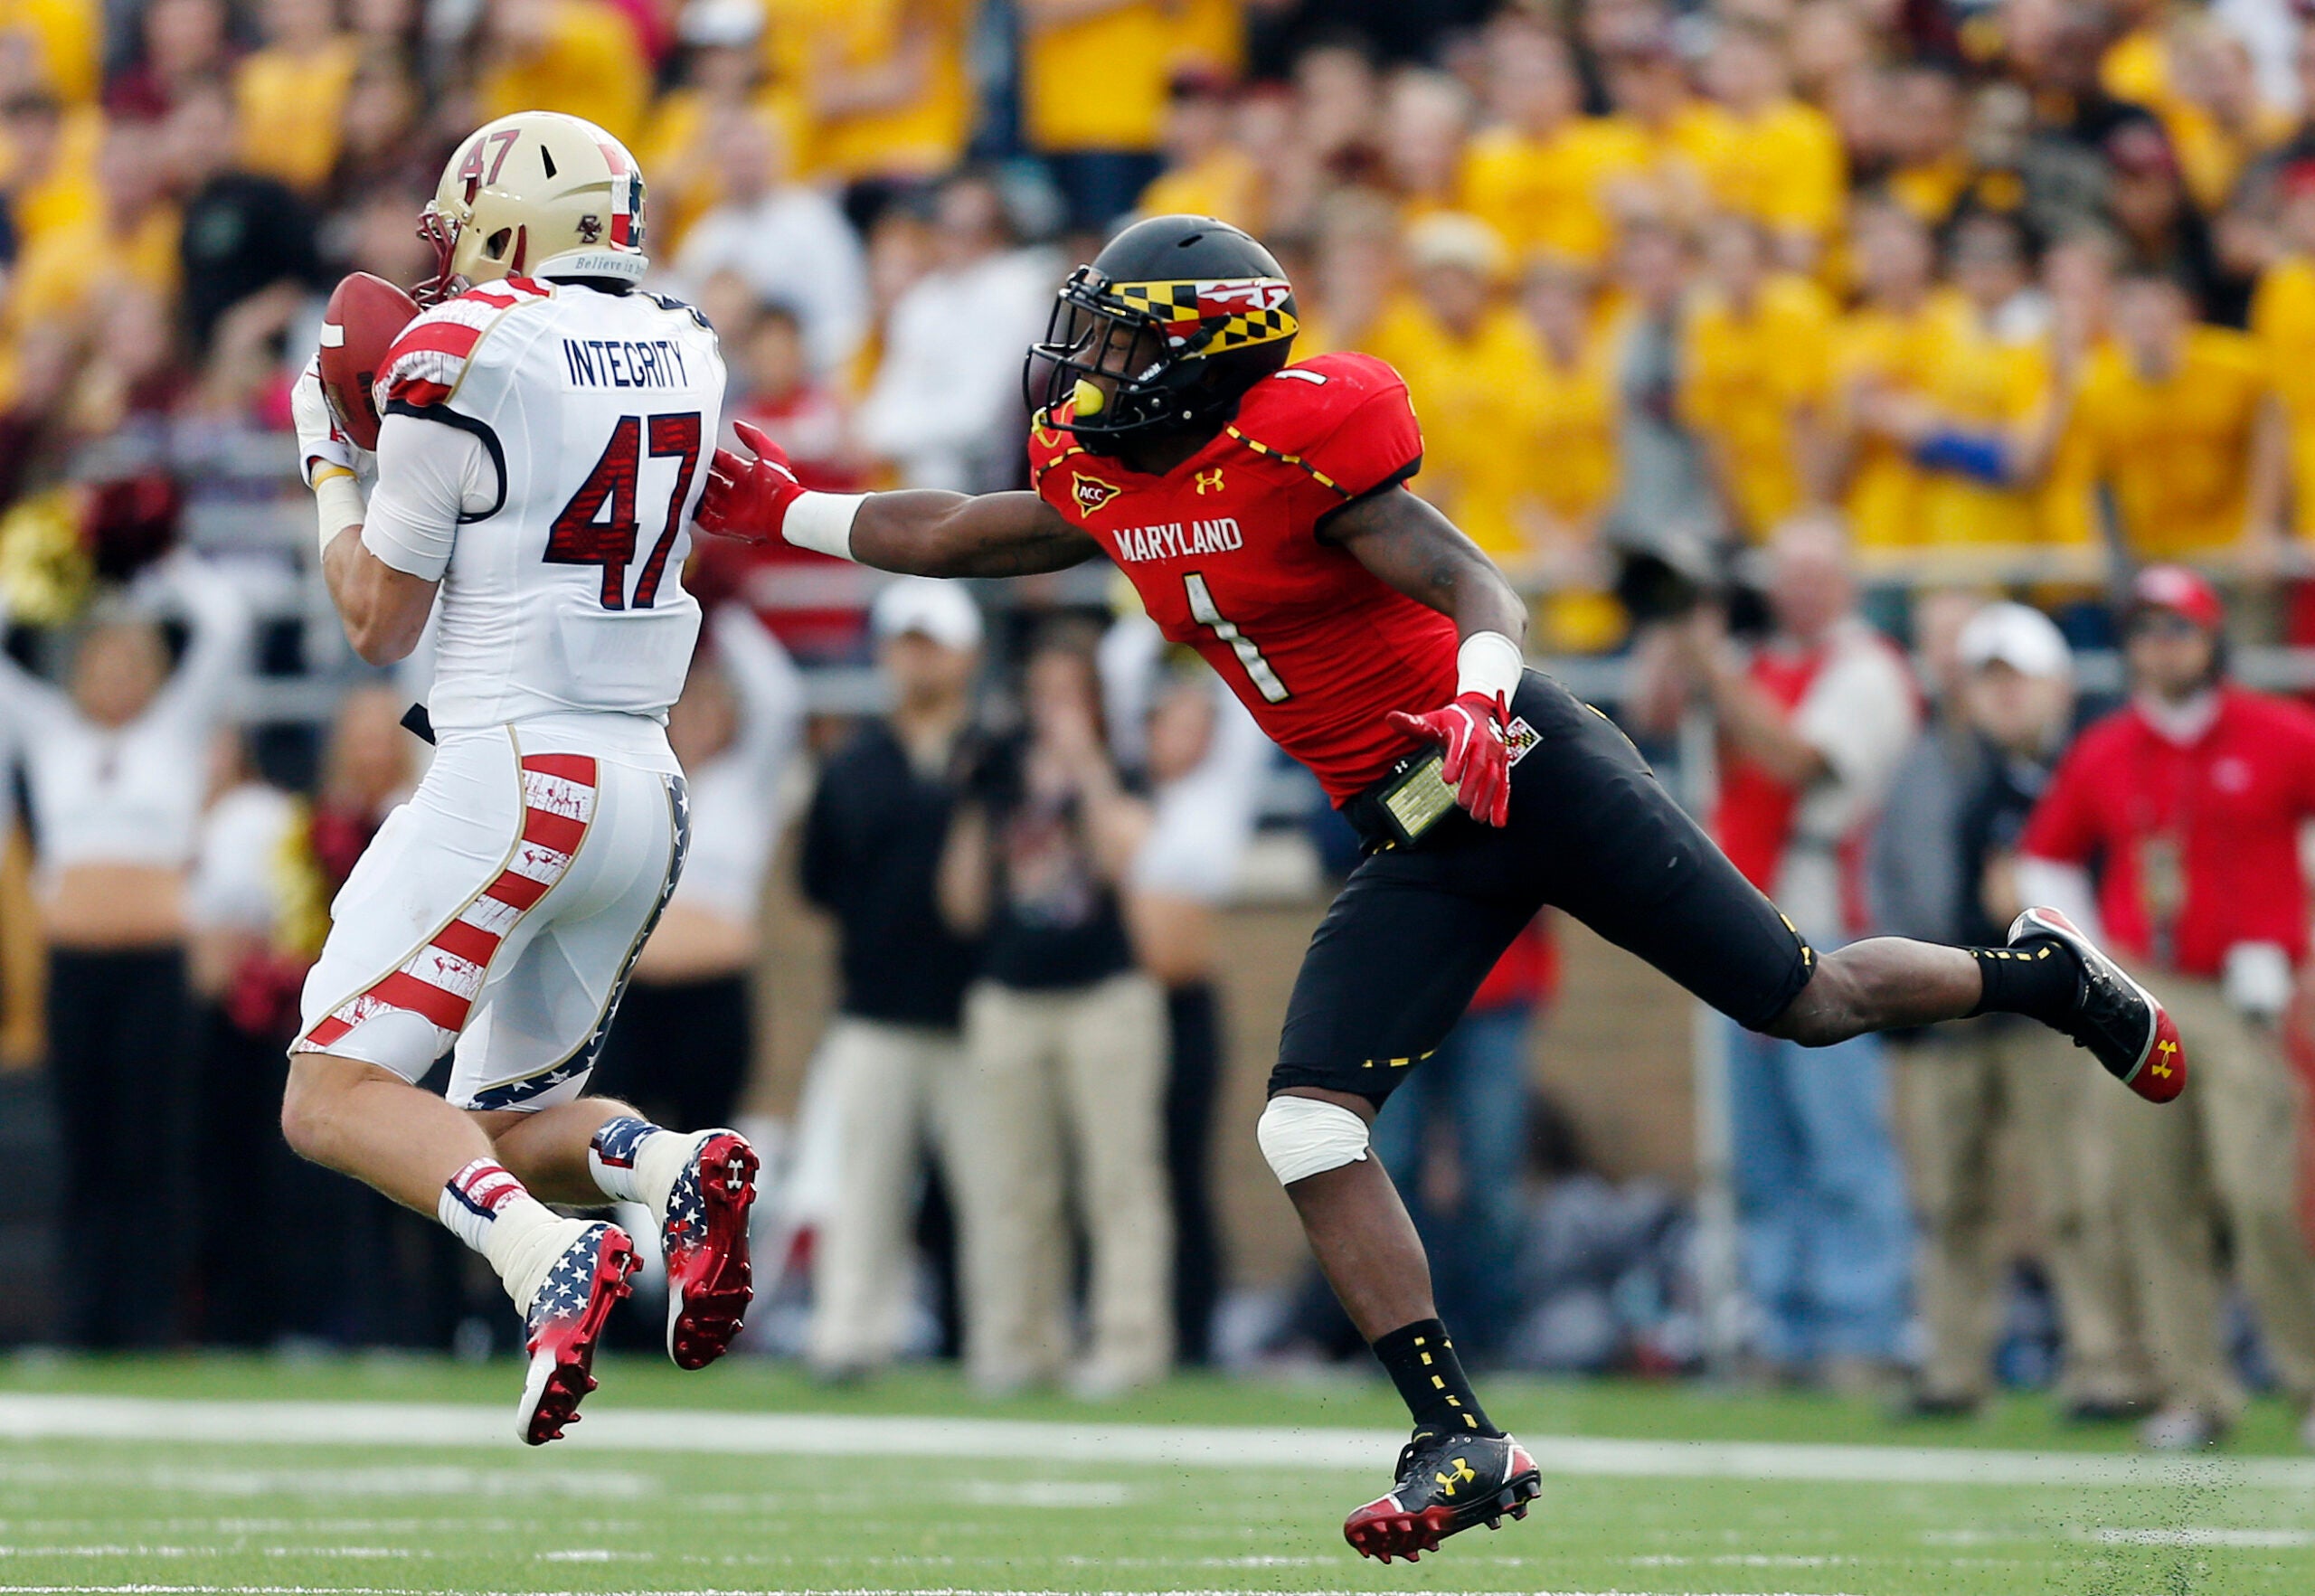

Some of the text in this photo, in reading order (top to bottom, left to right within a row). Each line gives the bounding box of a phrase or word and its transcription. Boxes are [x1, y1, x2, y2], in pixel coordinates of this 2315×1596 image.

[458, 128, 522, 188] 47
[575, 256, 622, 271] Believe
[562, 338, 689, 387] INTEGRITY
[542, 411, 702, 611] 47
[1079, 485, 1104, 502] ACC
[1112, 517, 1244, 562] MARYLAND
[1181, 571, 1293, 704] 1
